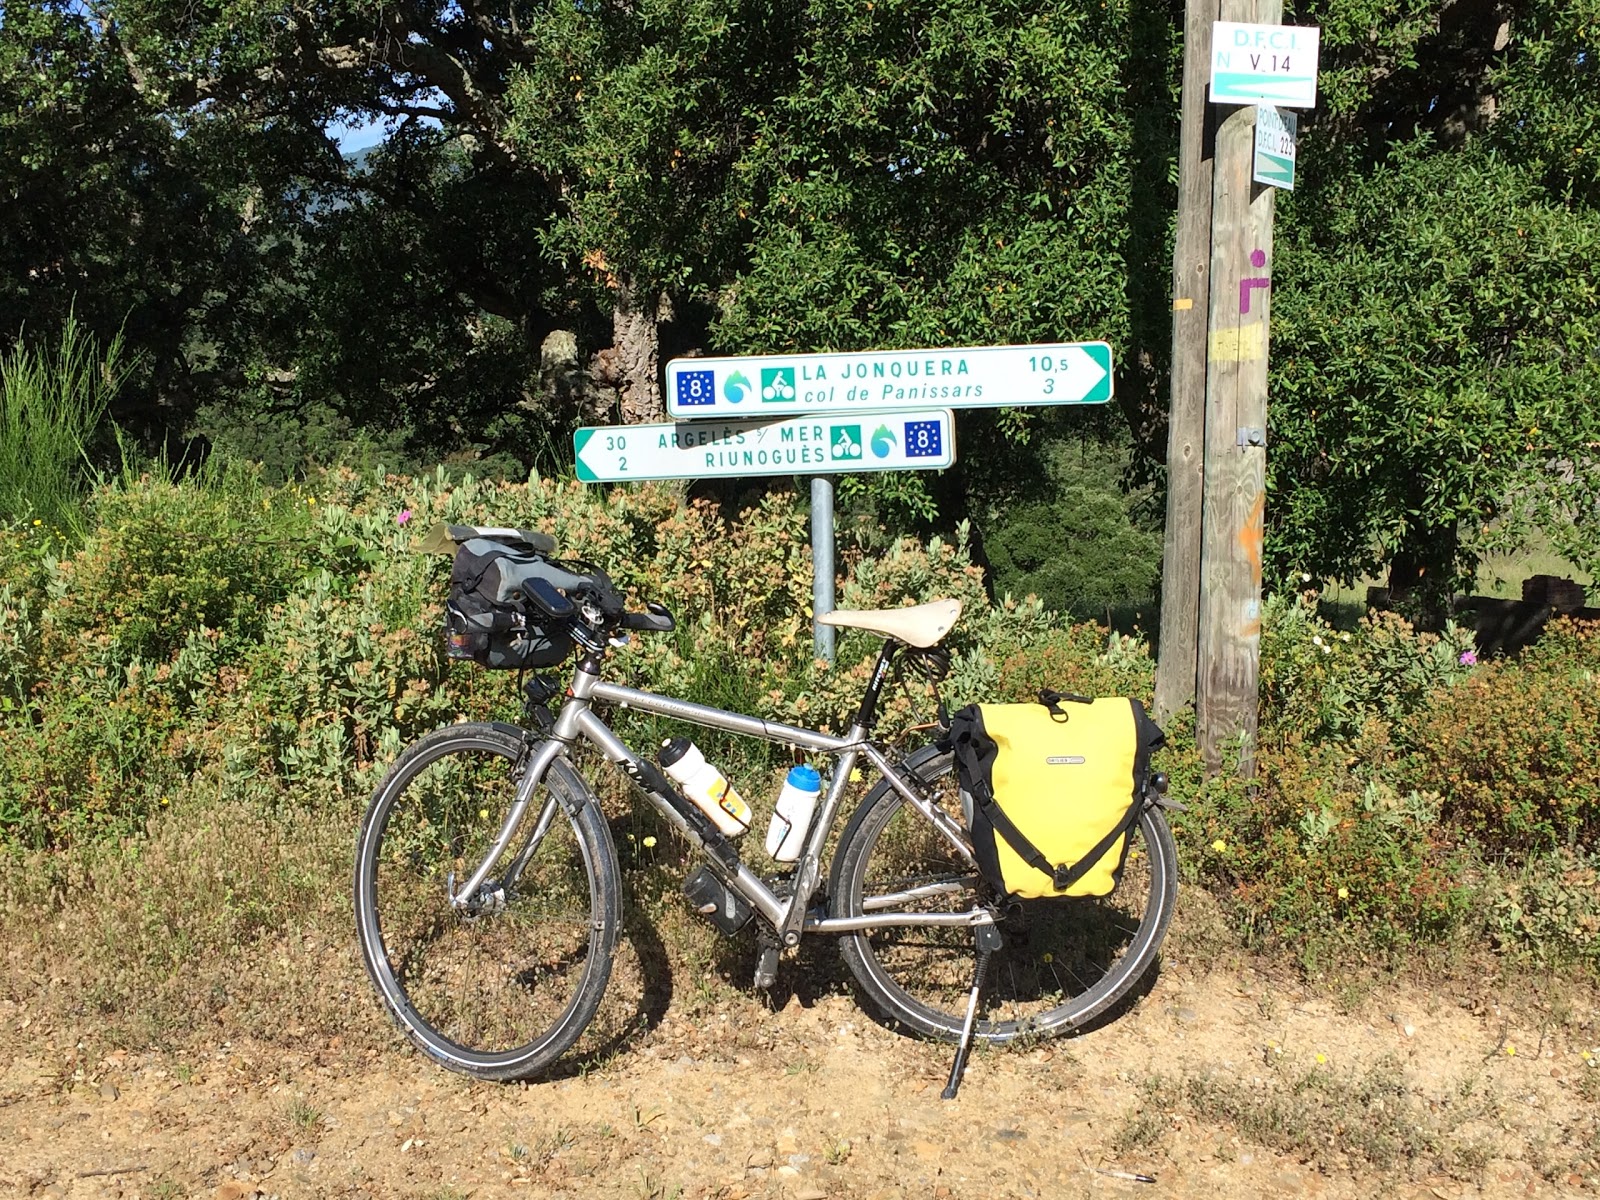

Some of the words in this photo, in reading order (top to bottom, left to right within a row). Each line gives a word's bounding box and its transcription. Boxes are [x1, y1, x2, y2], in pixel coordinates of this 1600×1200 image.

[1280, 136, 1293, 156] 223
[802, 364, 827, 380] LA
[841, 359, 969, 379] JONQUERA
[1029, 356, 1069, 373] 10,5
[690, 379, 702, 397] 8
[804, 386, 835, 403] col
[847, 386, 869, 401] de
[882, 382, 983, 400] Panissars
[1043, 378, 1055, 394] 3
[606, 436, 627, 451] 30
[658, 427, 746, 449] ARGELÈS
[781, 426, 823, 442] MER
[917, 430, 929, 448] 8
[619, 456, 628, 471] 2
[706, 445, 825, 467] RIUNOGUÈS
